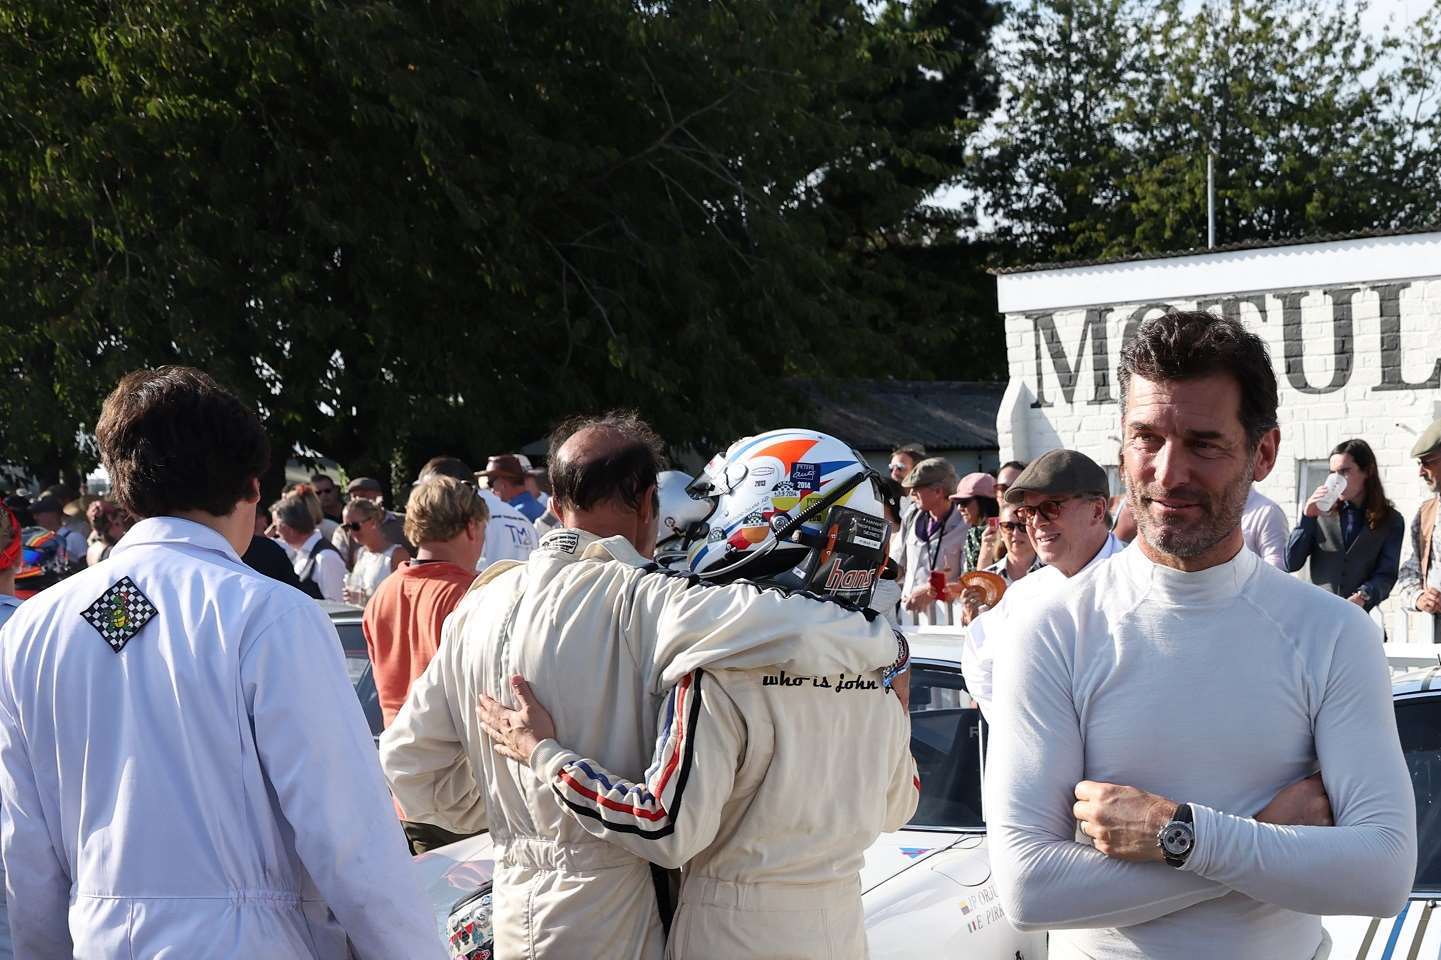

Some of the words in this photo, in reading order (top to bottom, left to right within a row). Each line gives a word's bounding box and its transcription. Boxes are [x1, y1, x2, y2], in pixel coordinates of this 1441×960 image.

[1023, 283, 1441, 408] MUL
[824, 558, 876, 597] hans
[762, 670, 810, 687] who
[812, 676, 832, 688] is
[835, 673, 878, 693] john
